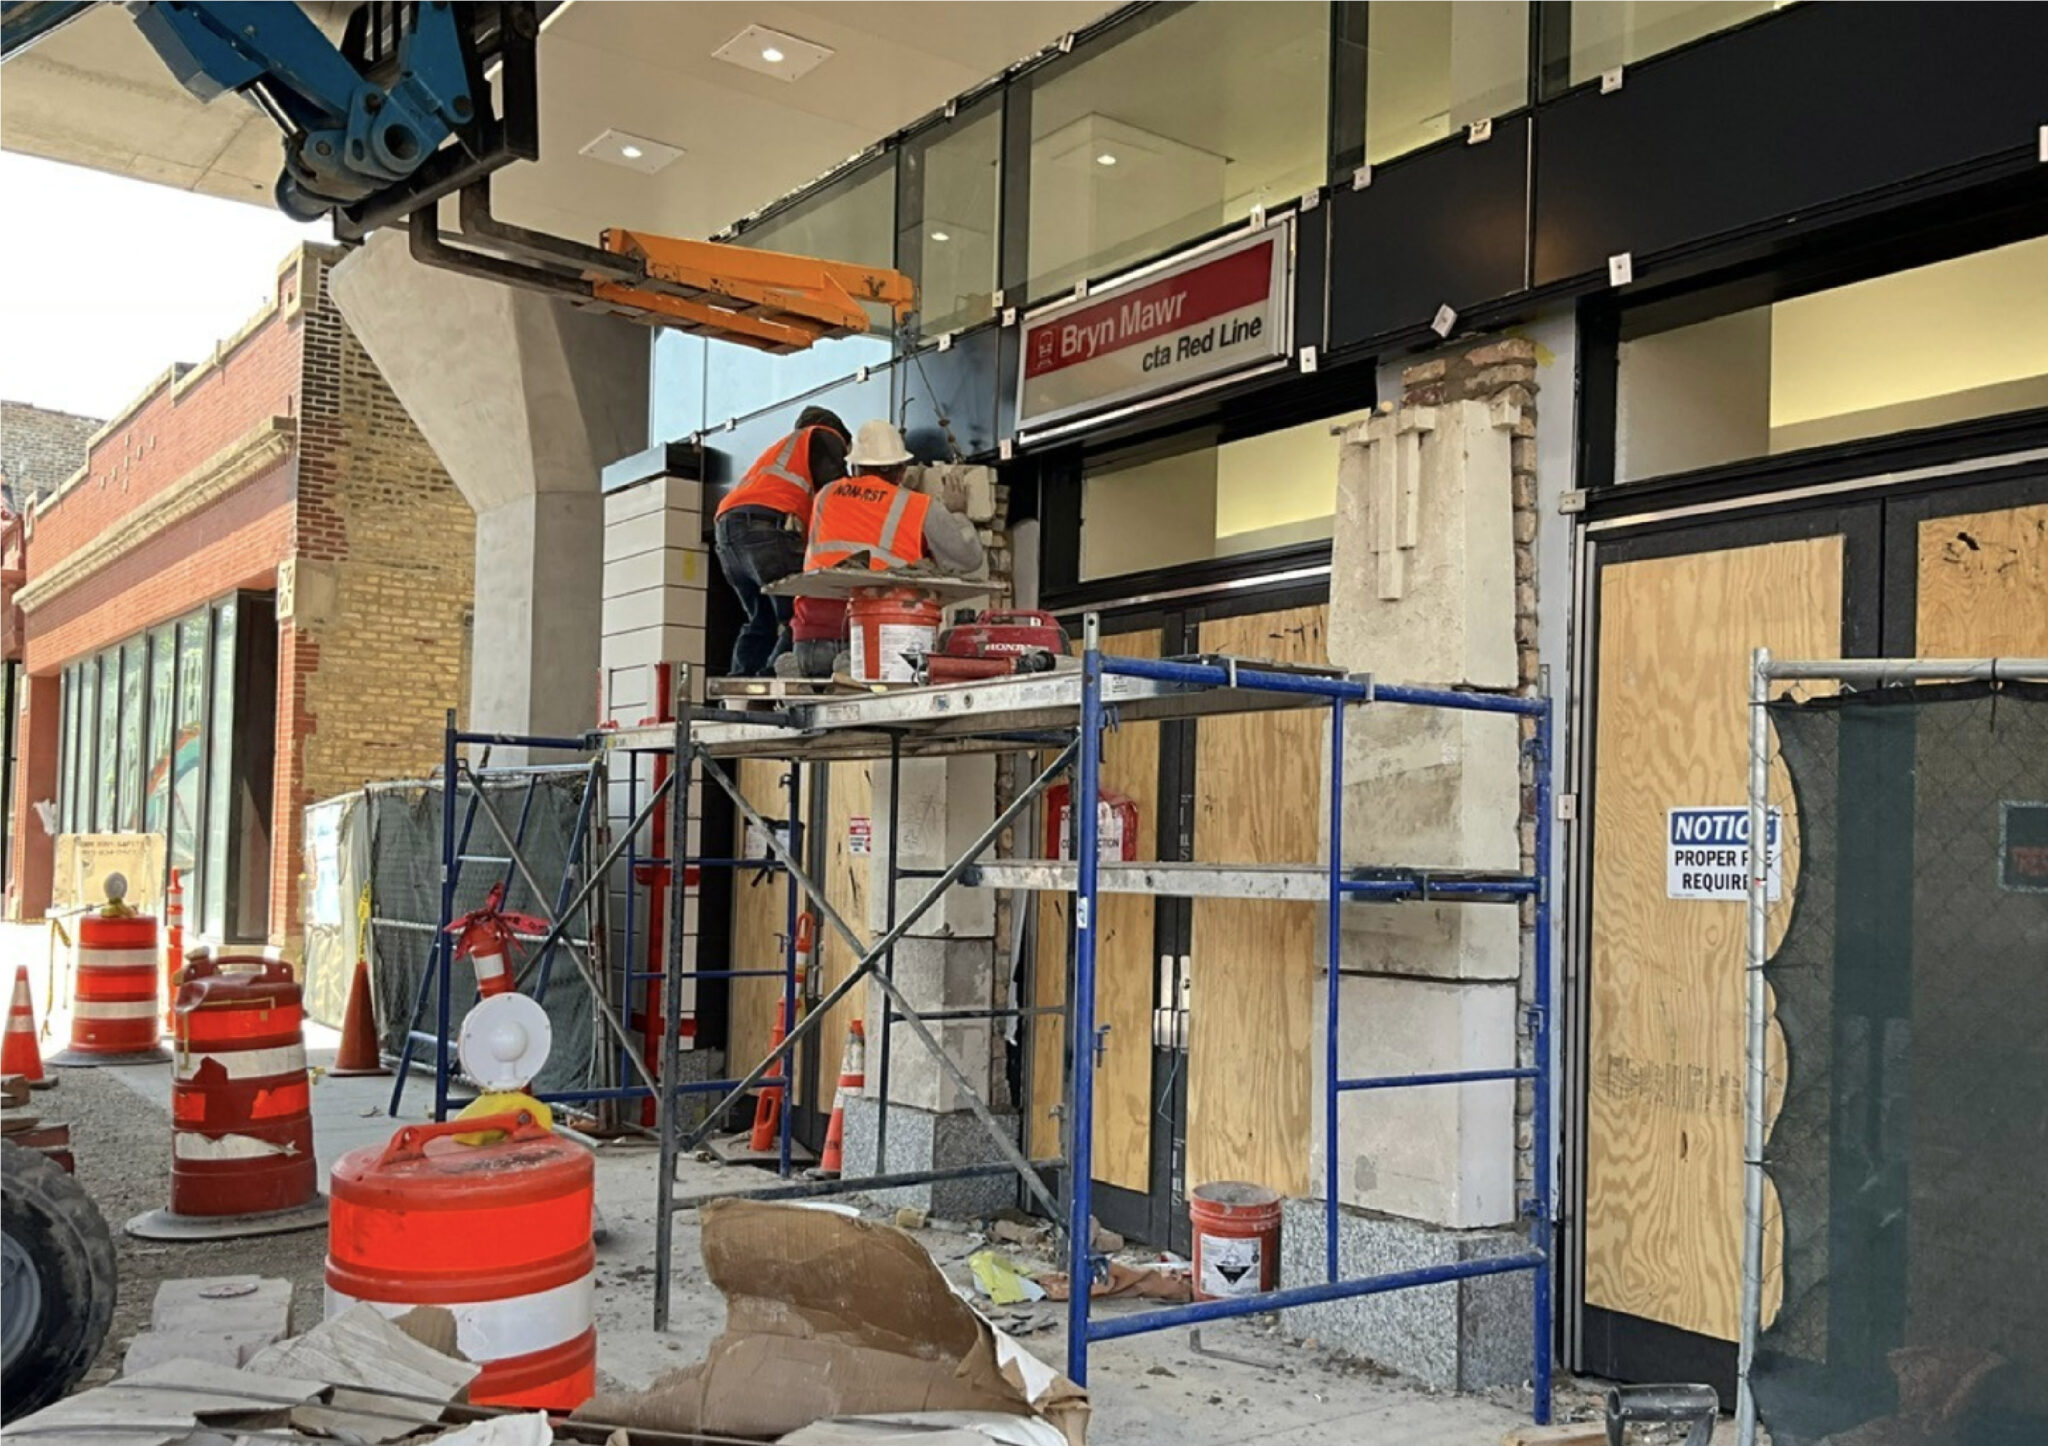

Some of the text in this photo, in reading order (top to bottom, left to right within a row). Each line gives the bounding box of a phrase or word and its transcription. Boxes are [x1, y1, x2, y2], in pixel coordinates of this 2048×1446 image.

[1060, 291, 1187, 359] Bryn Mawr
[1142, 316, 1262, 373] cta Red Line
[984, 643, 1032, 652] HOND
[1675, 850, 1737, 867] PROPER
